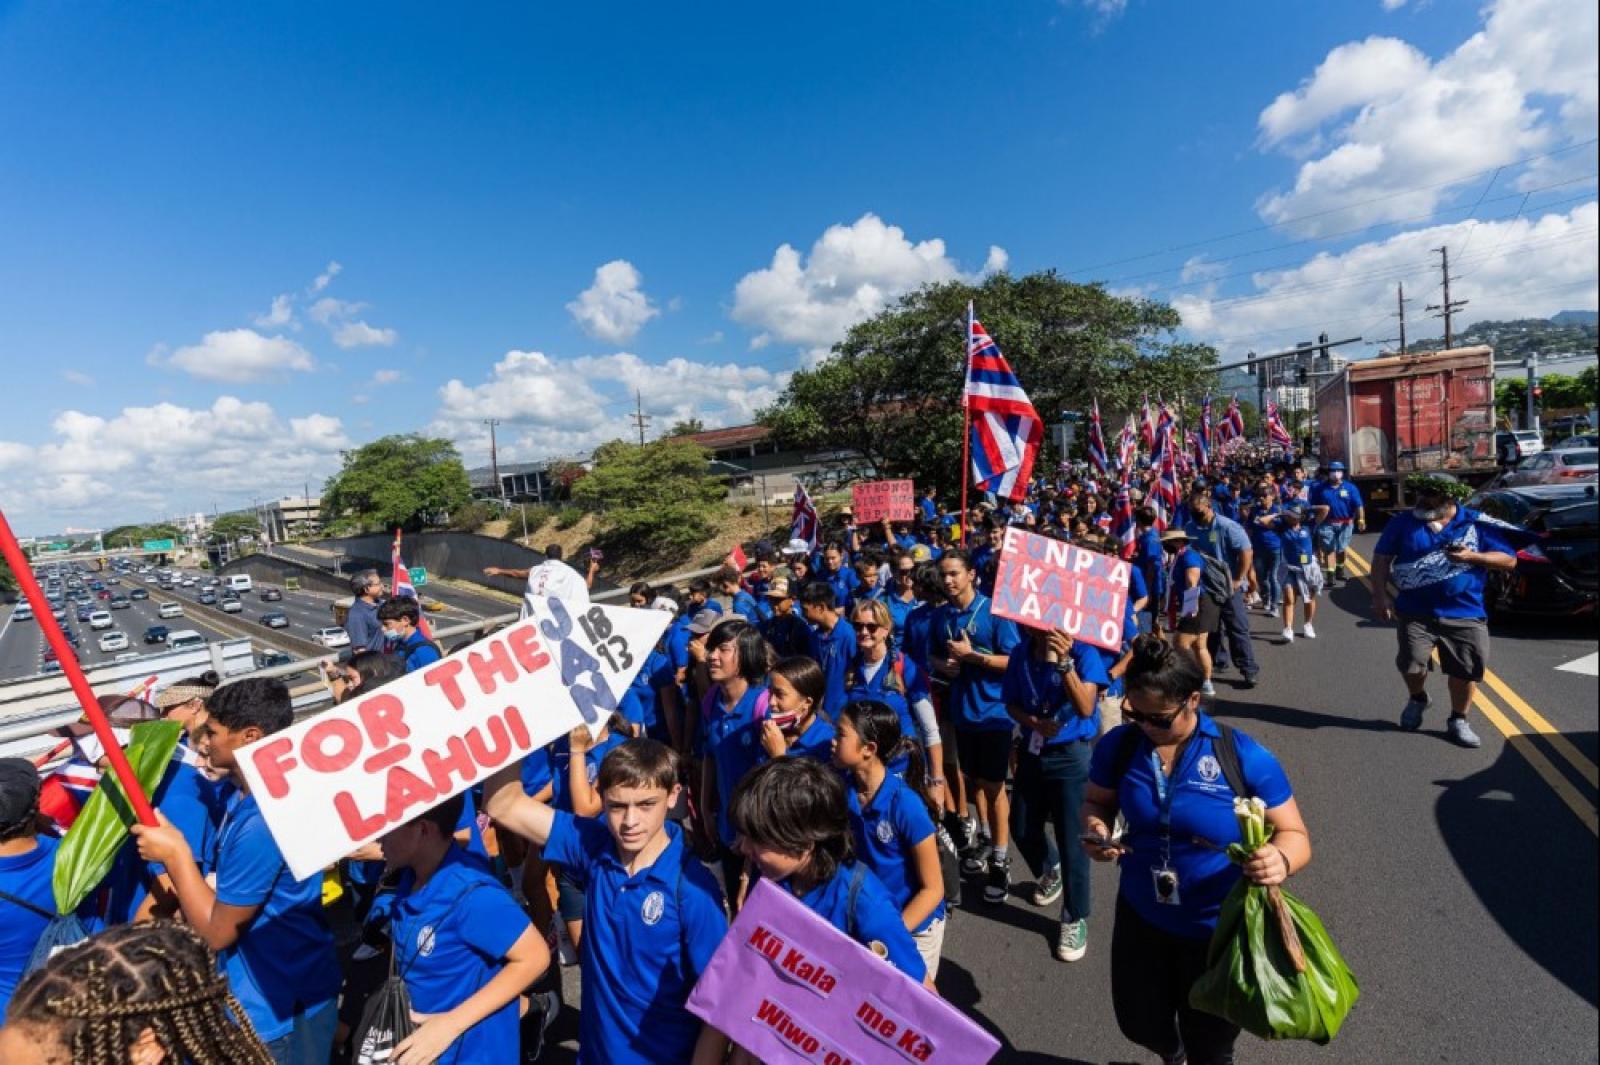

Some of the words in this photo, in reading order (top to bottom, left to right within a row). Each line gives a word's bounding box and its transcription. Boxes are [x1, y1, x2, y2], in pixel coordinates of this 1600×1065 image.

[855, 482, 910, 495] STRONG
[1002, 527, 1018, 554] E
[578, 606, 612, 646] 18
[541, 596, 617, 724] JAN
[597, 635, 633, 673] 93
[253, 693, 410, 799] FOR
[424, 625, 551, 710] THE
[781, 948, 836, 993] Kala
[856, 1001, 897, 1038] me
[897, 1029, 932, 1062] Ka
